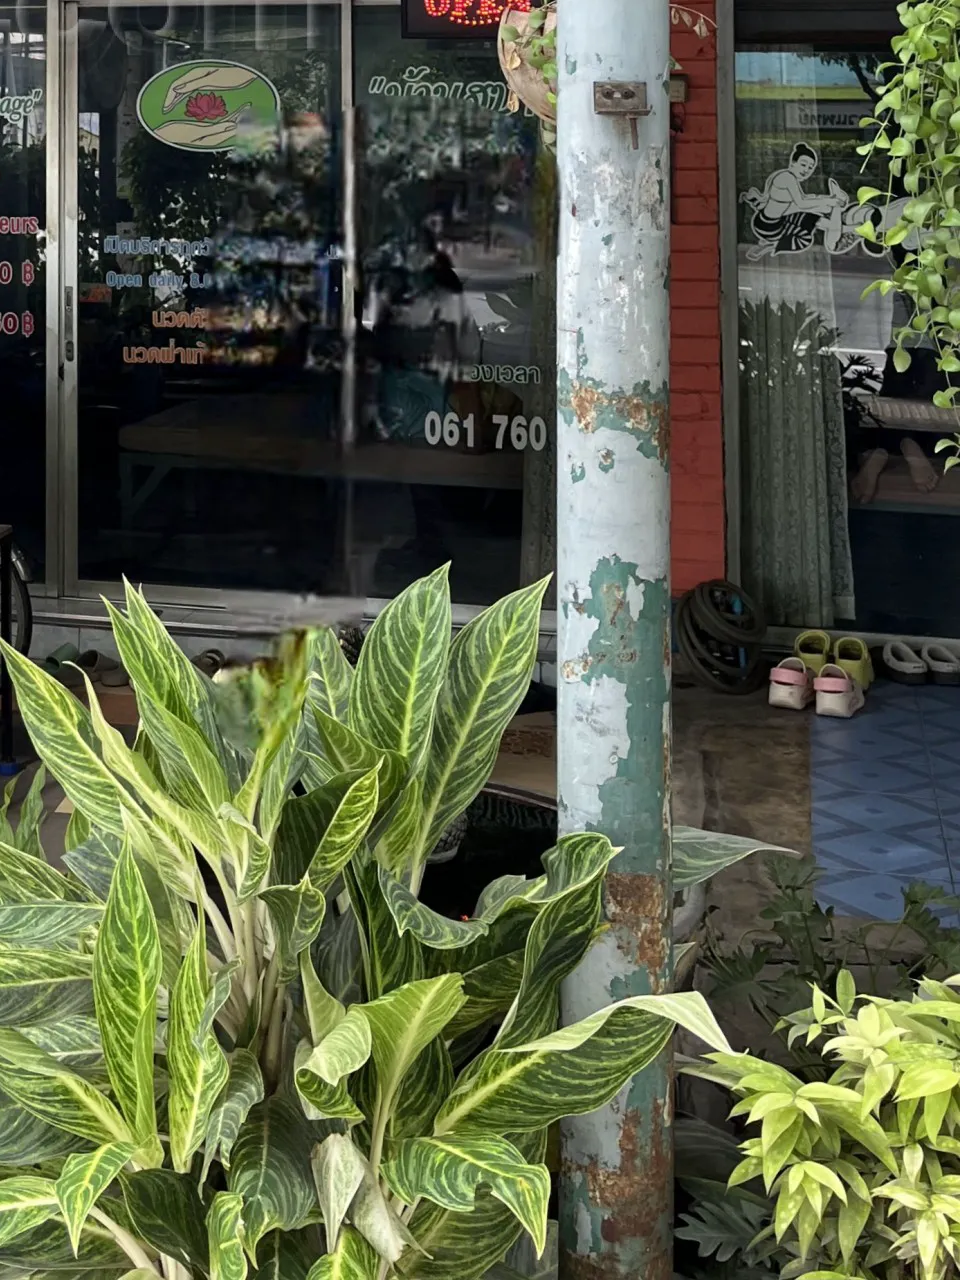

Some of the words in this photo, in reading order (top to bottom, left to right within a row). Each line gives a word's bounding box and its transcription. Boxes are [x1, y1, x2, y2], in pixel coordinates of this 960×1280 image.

[105, 270, 143, 290] Open
[148, 272, 184, 289] daily
[424, 410, 475, 449] 061
[491, 414, 547, 452] 760
